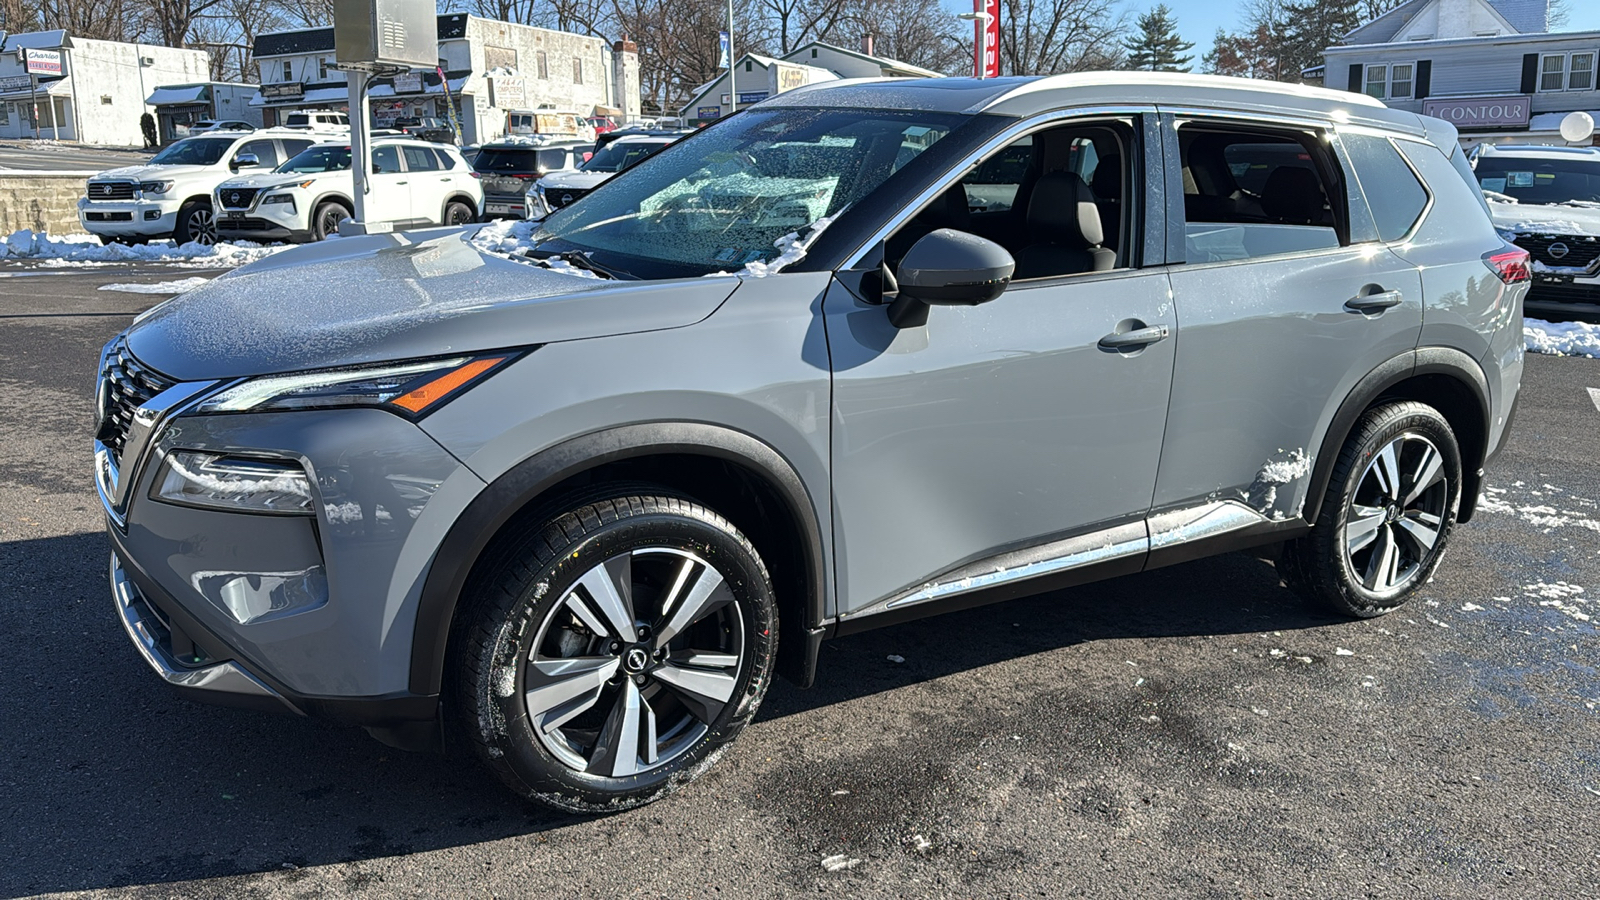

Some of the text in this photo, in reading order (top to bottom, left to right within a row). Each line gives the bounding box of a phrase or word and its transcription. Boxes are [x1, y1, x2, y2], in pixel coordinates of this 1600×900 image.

[28, 51, 59, 60] Charles
[496, 86, 523, 94] COMPUTERS
[1439, 105, 1522, 120] CONTOUR
[1361, 417, 1412, 466] OPTIMUM
